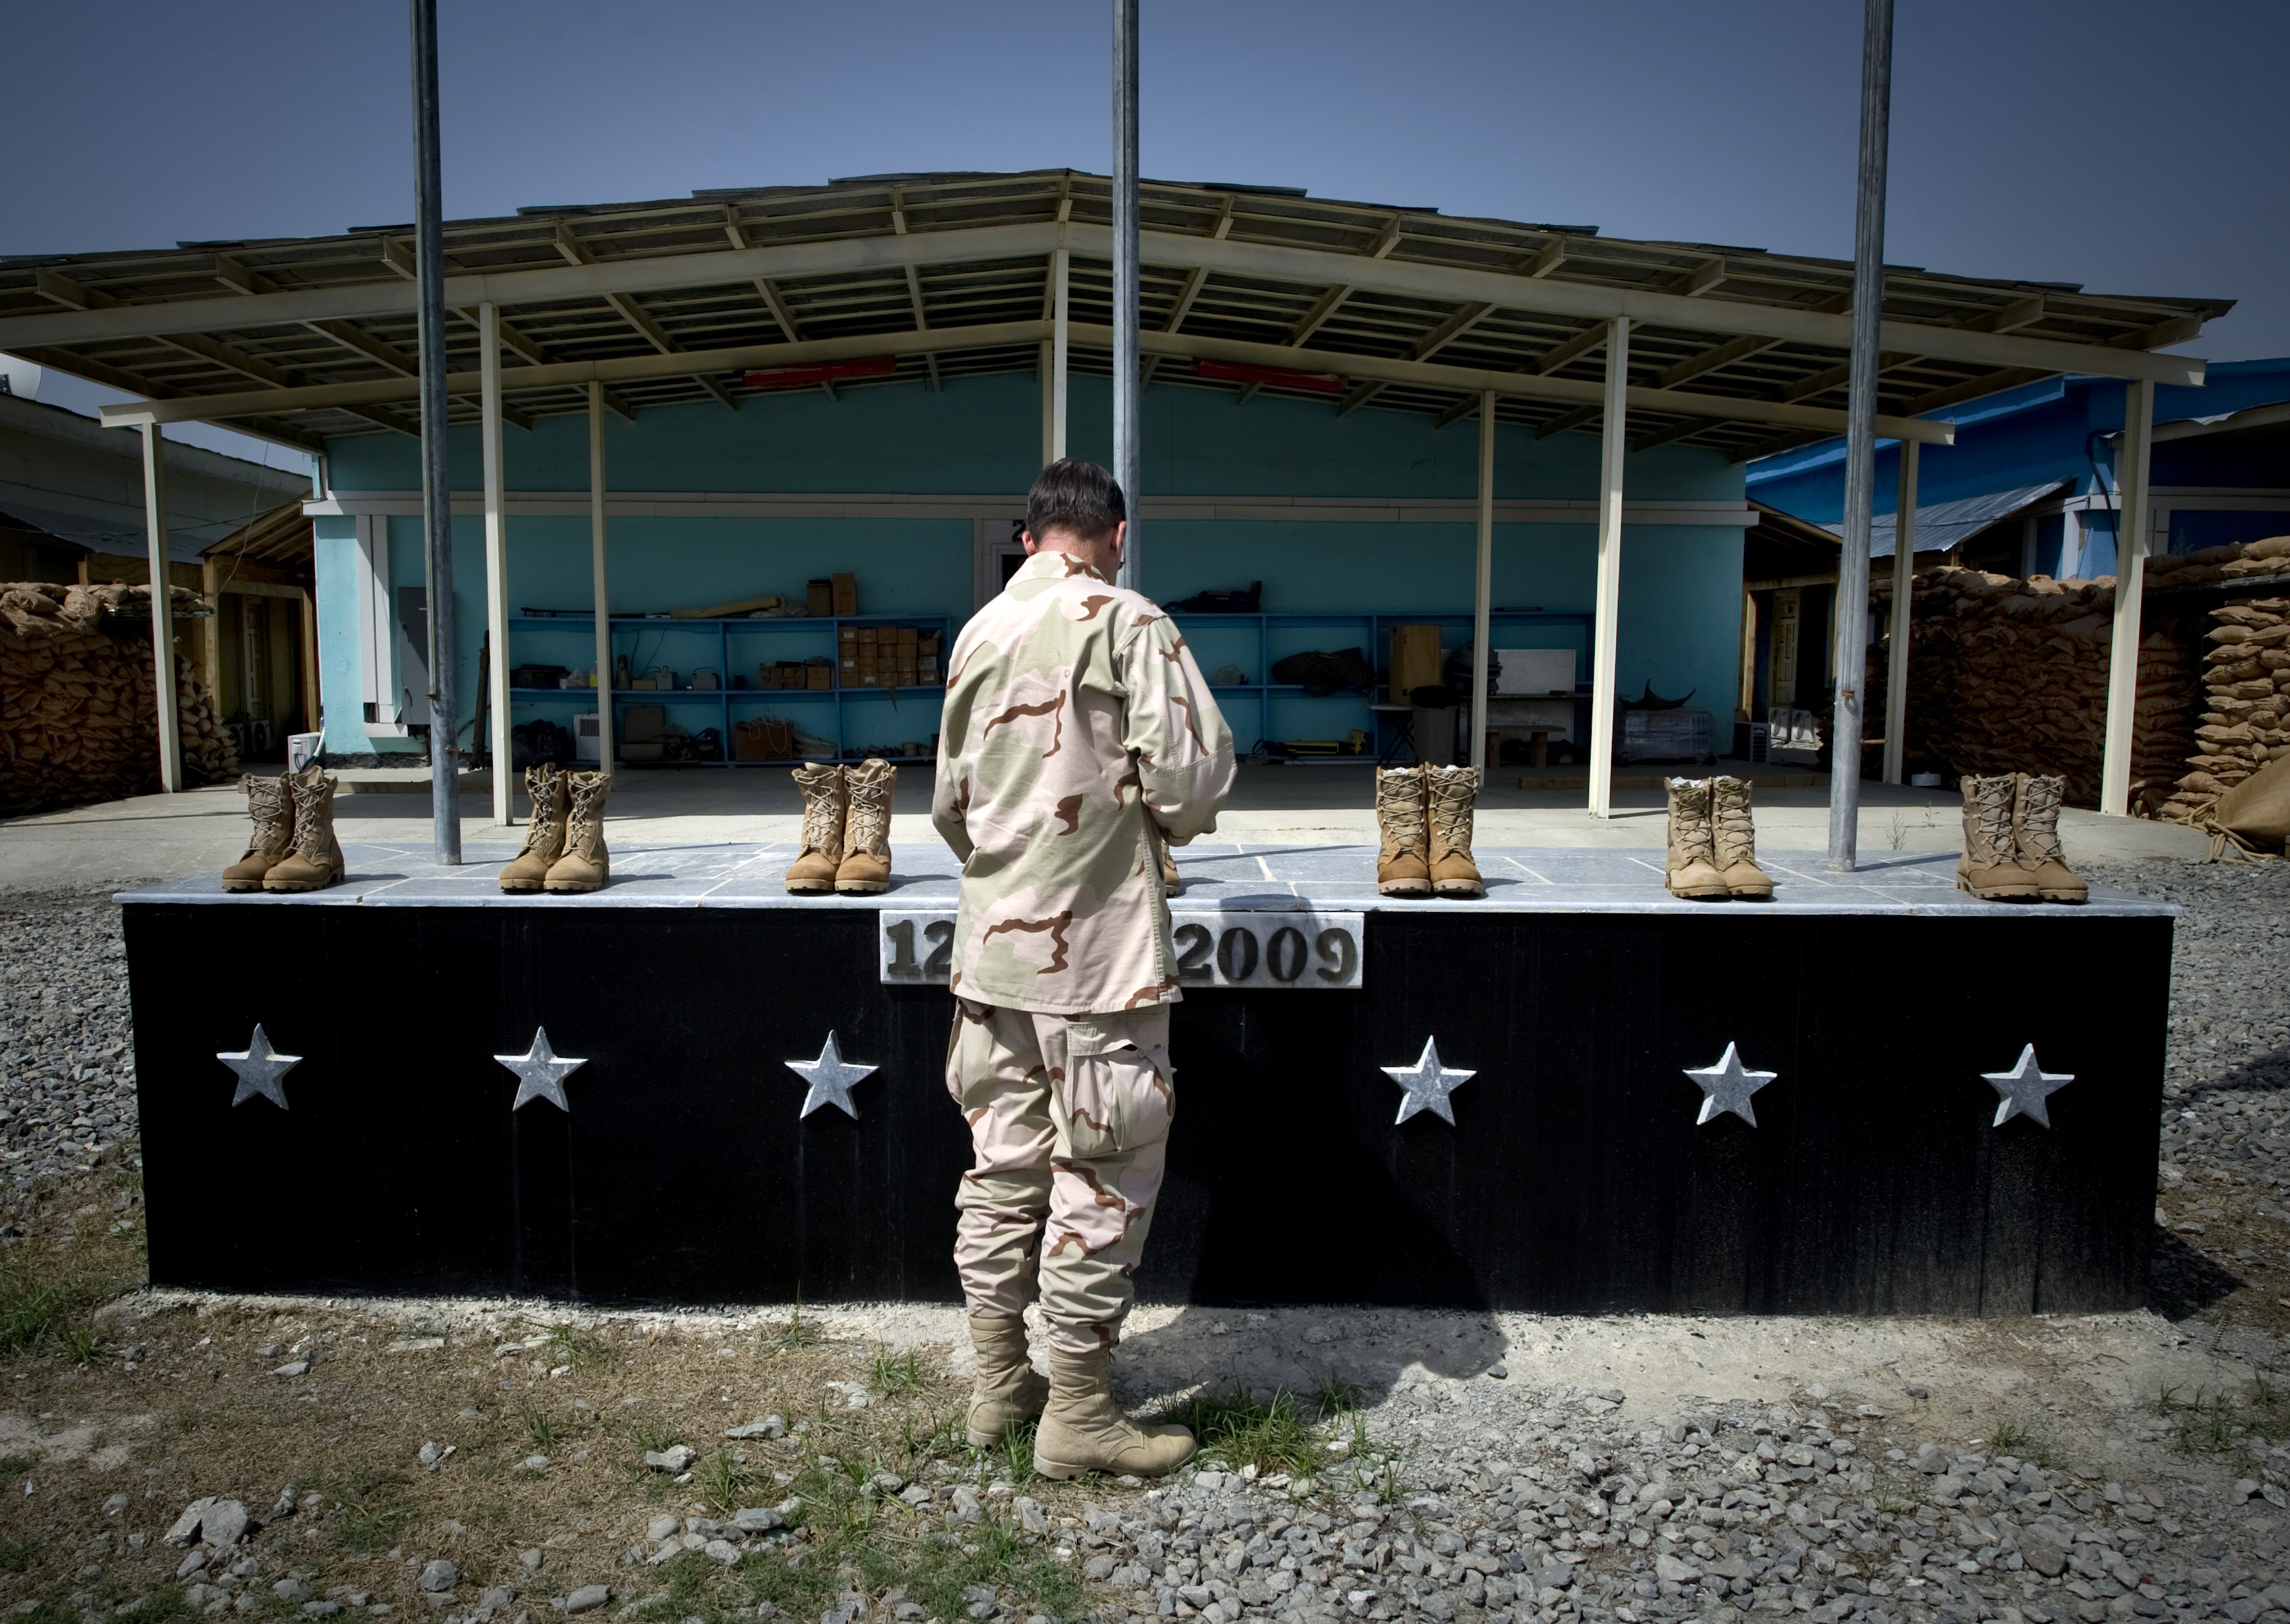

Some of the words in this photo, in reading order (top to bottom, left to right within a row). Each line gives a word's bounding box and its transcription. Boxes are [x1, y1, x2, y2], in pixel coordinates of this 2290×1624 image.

[1013, 520, 1026, 542] 2
[887, 921, 956, 975] 12
[1174, 923, 1355, 982] 2009
